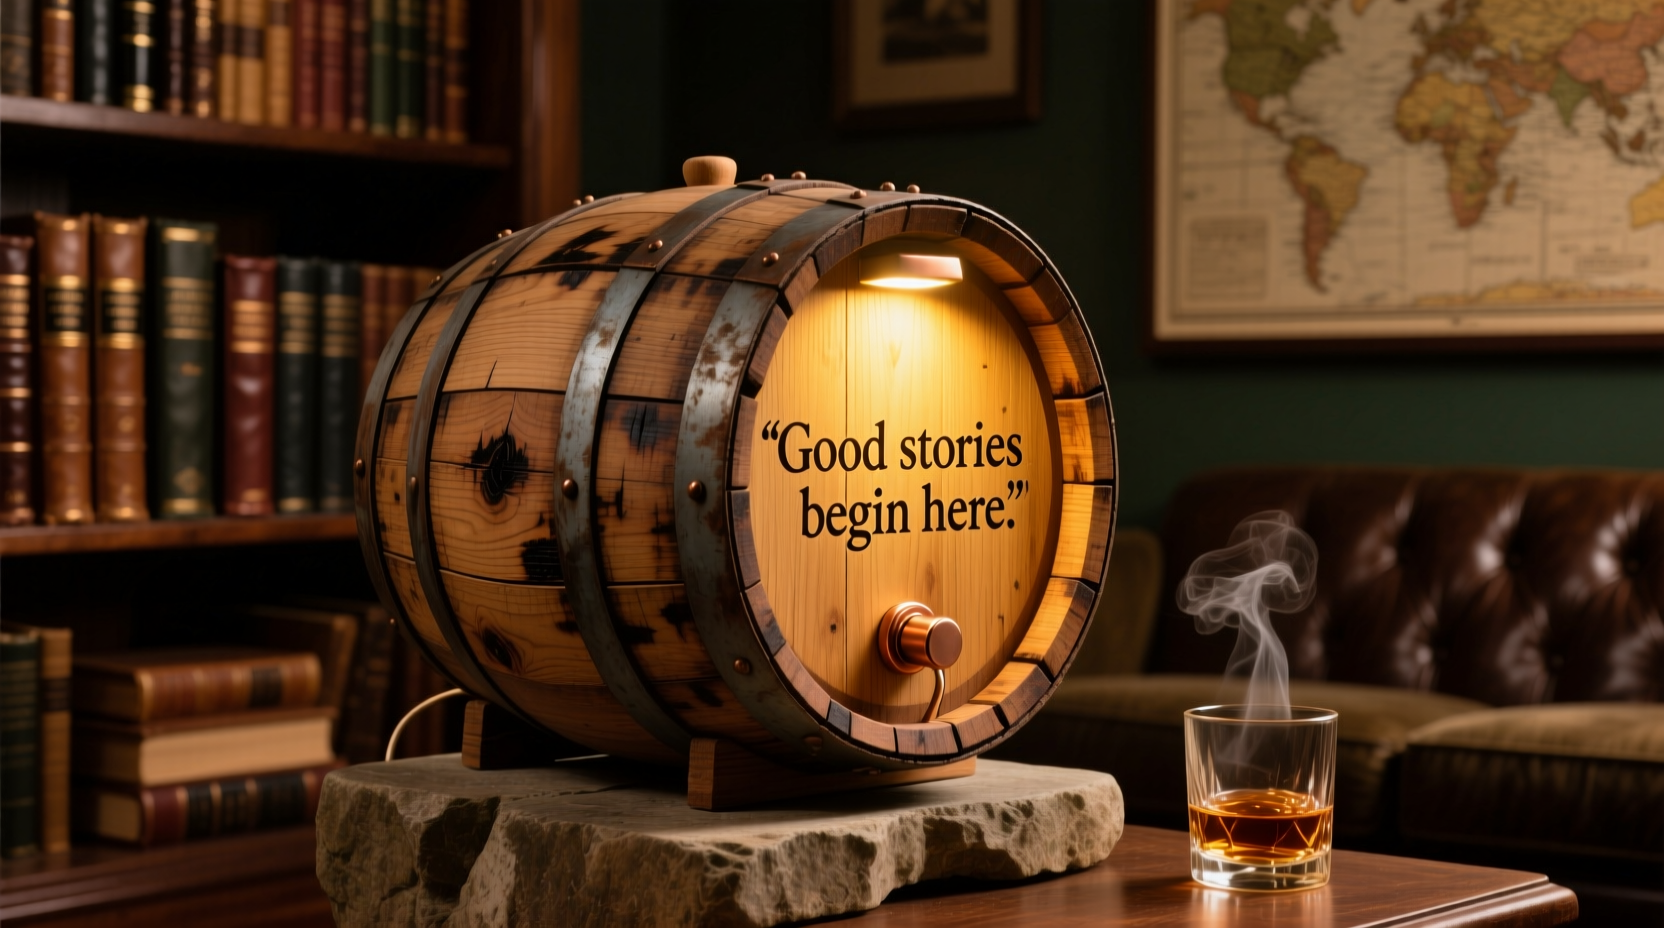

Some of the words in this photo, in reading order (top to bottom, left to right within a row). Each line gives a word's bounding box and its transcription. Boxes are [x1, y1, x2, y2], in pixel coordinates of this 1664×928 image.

[761, 420, 887, 473] “Good
[899, 421, 1022, 470] stories
[799, 486, 910, 551] begin
